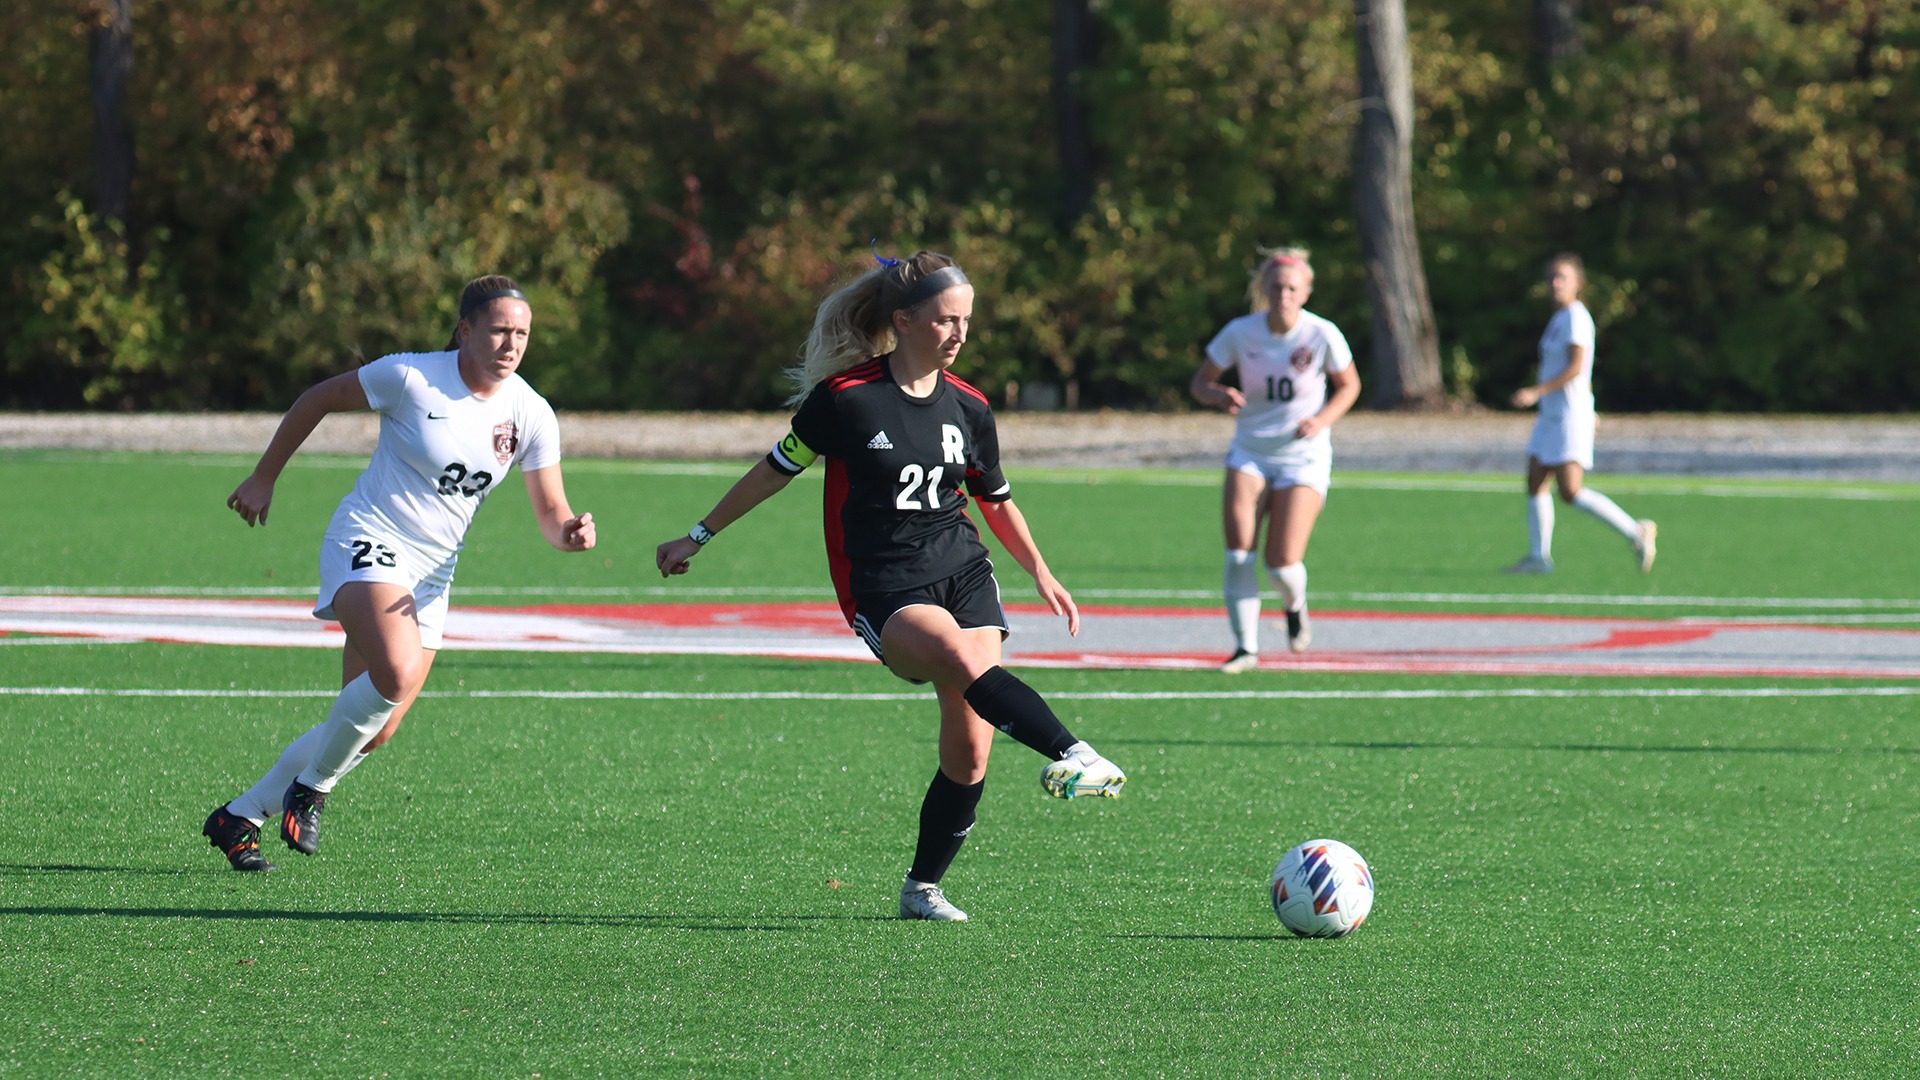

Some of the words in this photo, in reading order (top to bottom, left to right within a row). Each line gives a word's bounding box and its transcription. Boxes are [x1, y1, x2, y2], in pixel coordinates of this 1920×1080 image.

[1267, 376, 1293, 402] 10
[782, 433, 798, 453] C
[867, 442, 894, 450] adidas
[941, 424, 965, 464] R
[896, 463, 944, 510] 21
[351, 540, 396, 571] 23
